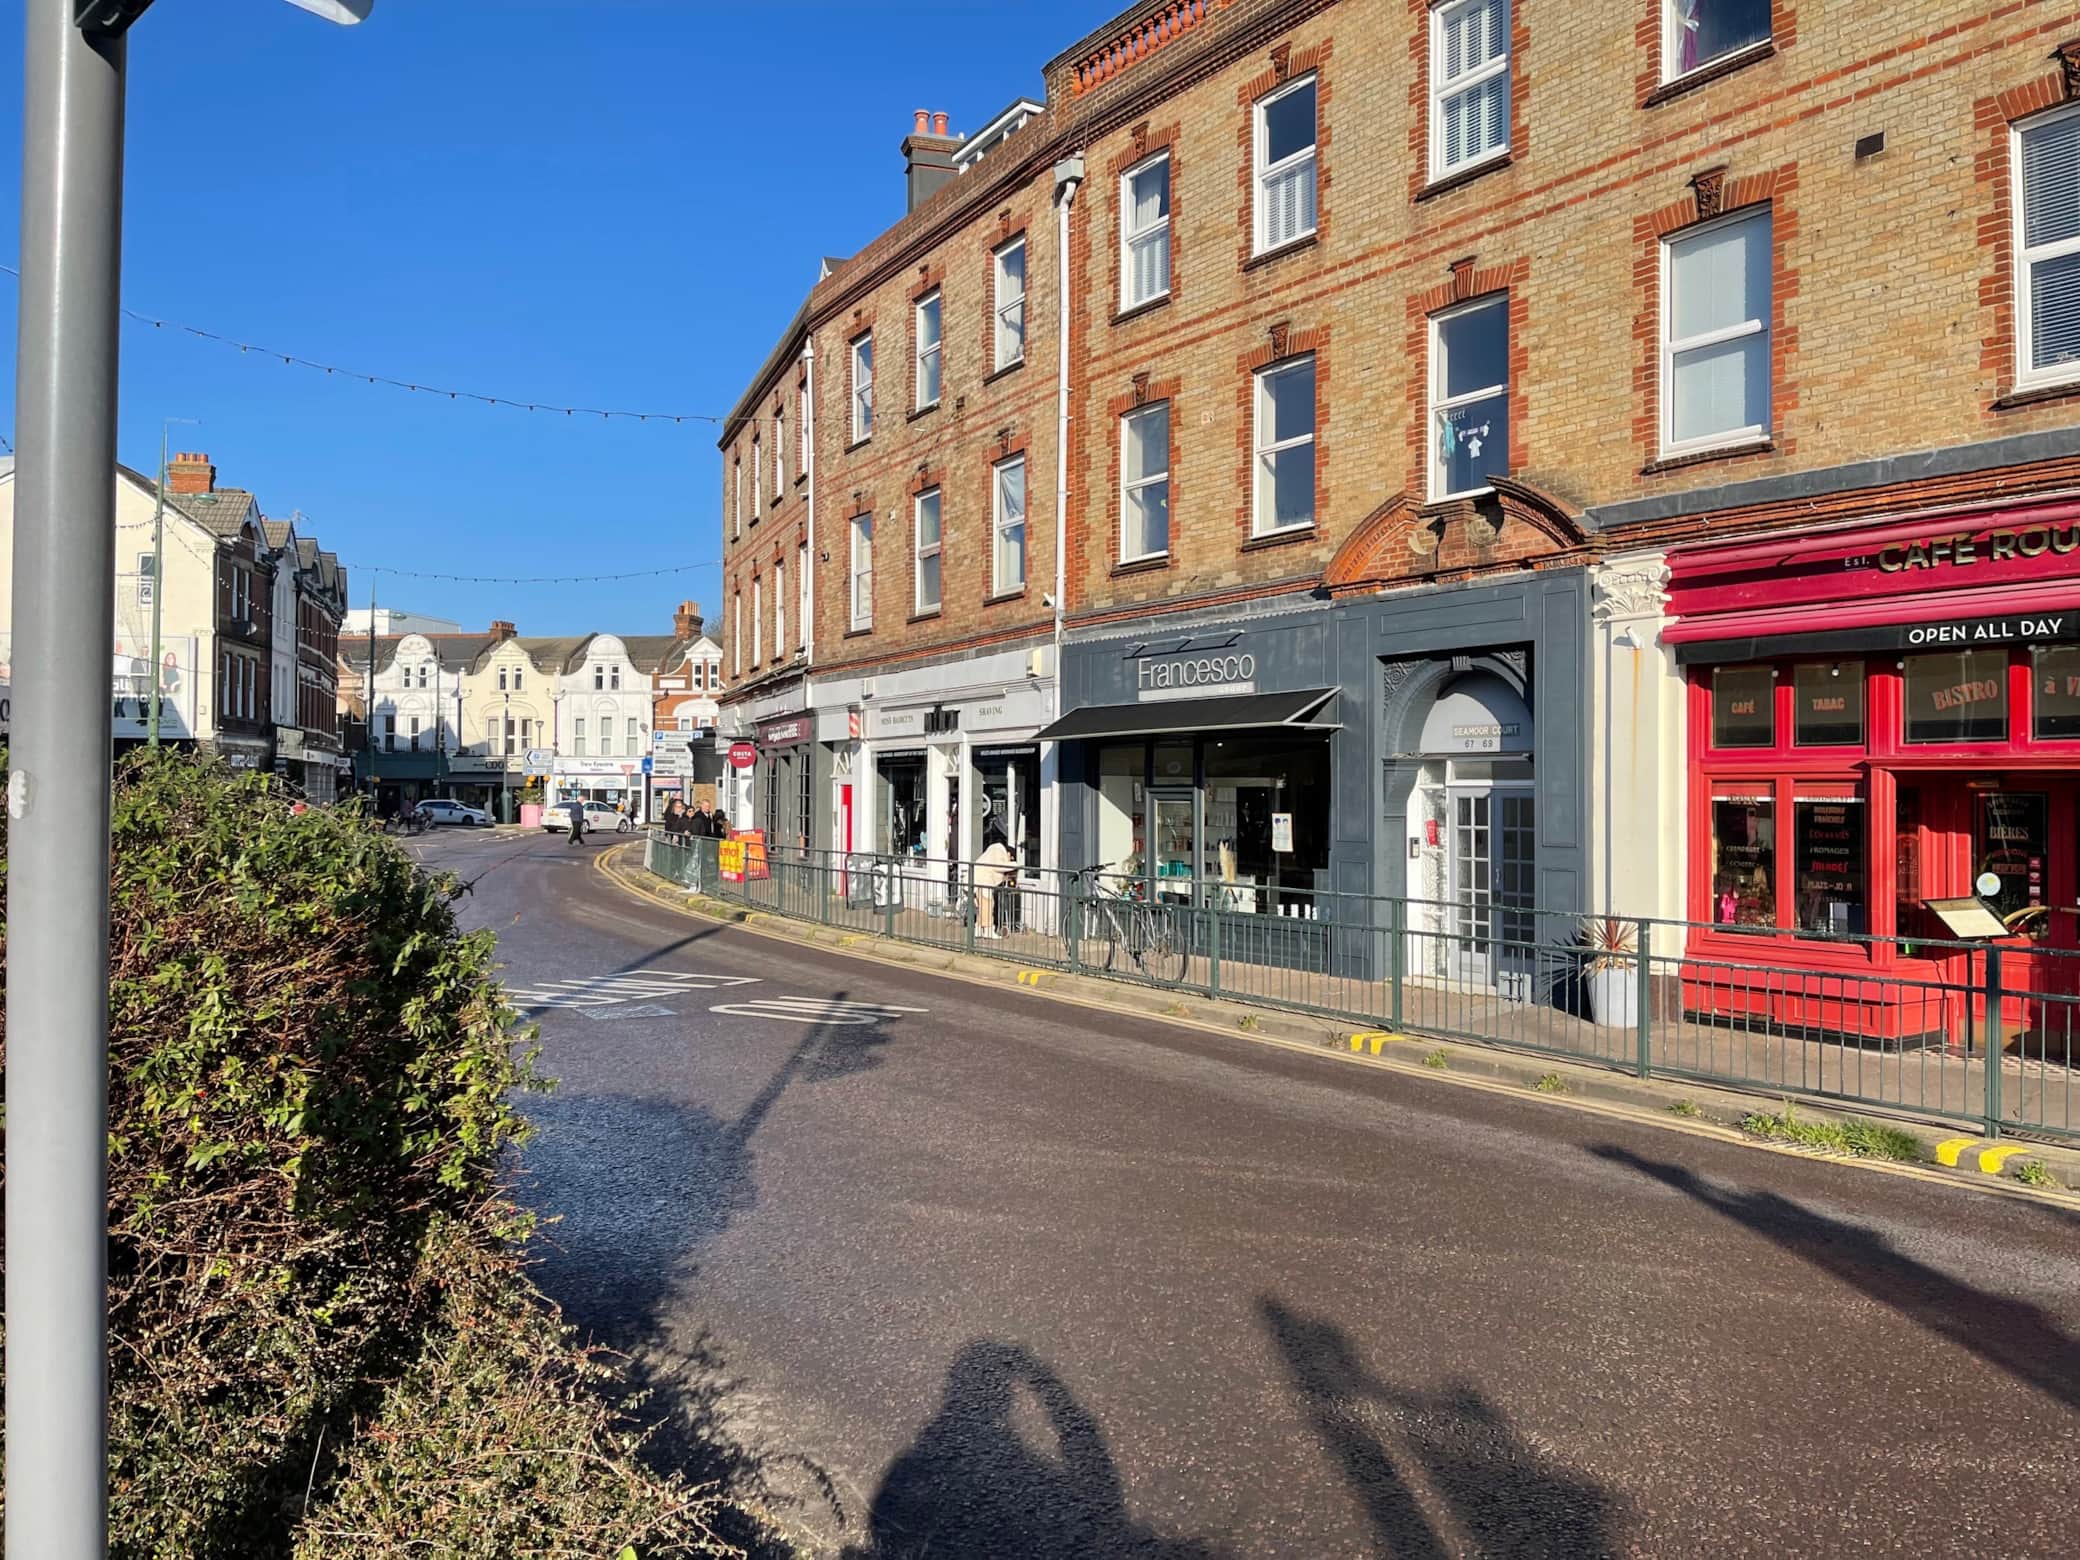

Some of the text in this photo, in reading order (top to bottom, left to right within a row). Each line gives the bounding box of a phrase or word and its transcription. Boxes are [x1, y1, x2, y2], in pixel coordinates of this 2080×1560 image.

[1909, 618, 2063, 644] OPEN ALL DAY
[1138, 654, 1255, 689] Francesco
[1812, 697, 1845, 711] TABAC
[1931, 679, 1998, 711] BISTRO
[1454, 725, 1519, 736] SEAMOOR COURT
[1465, 738, 1493, 748] 67 69
[709, 995, 930, 1025] NO
